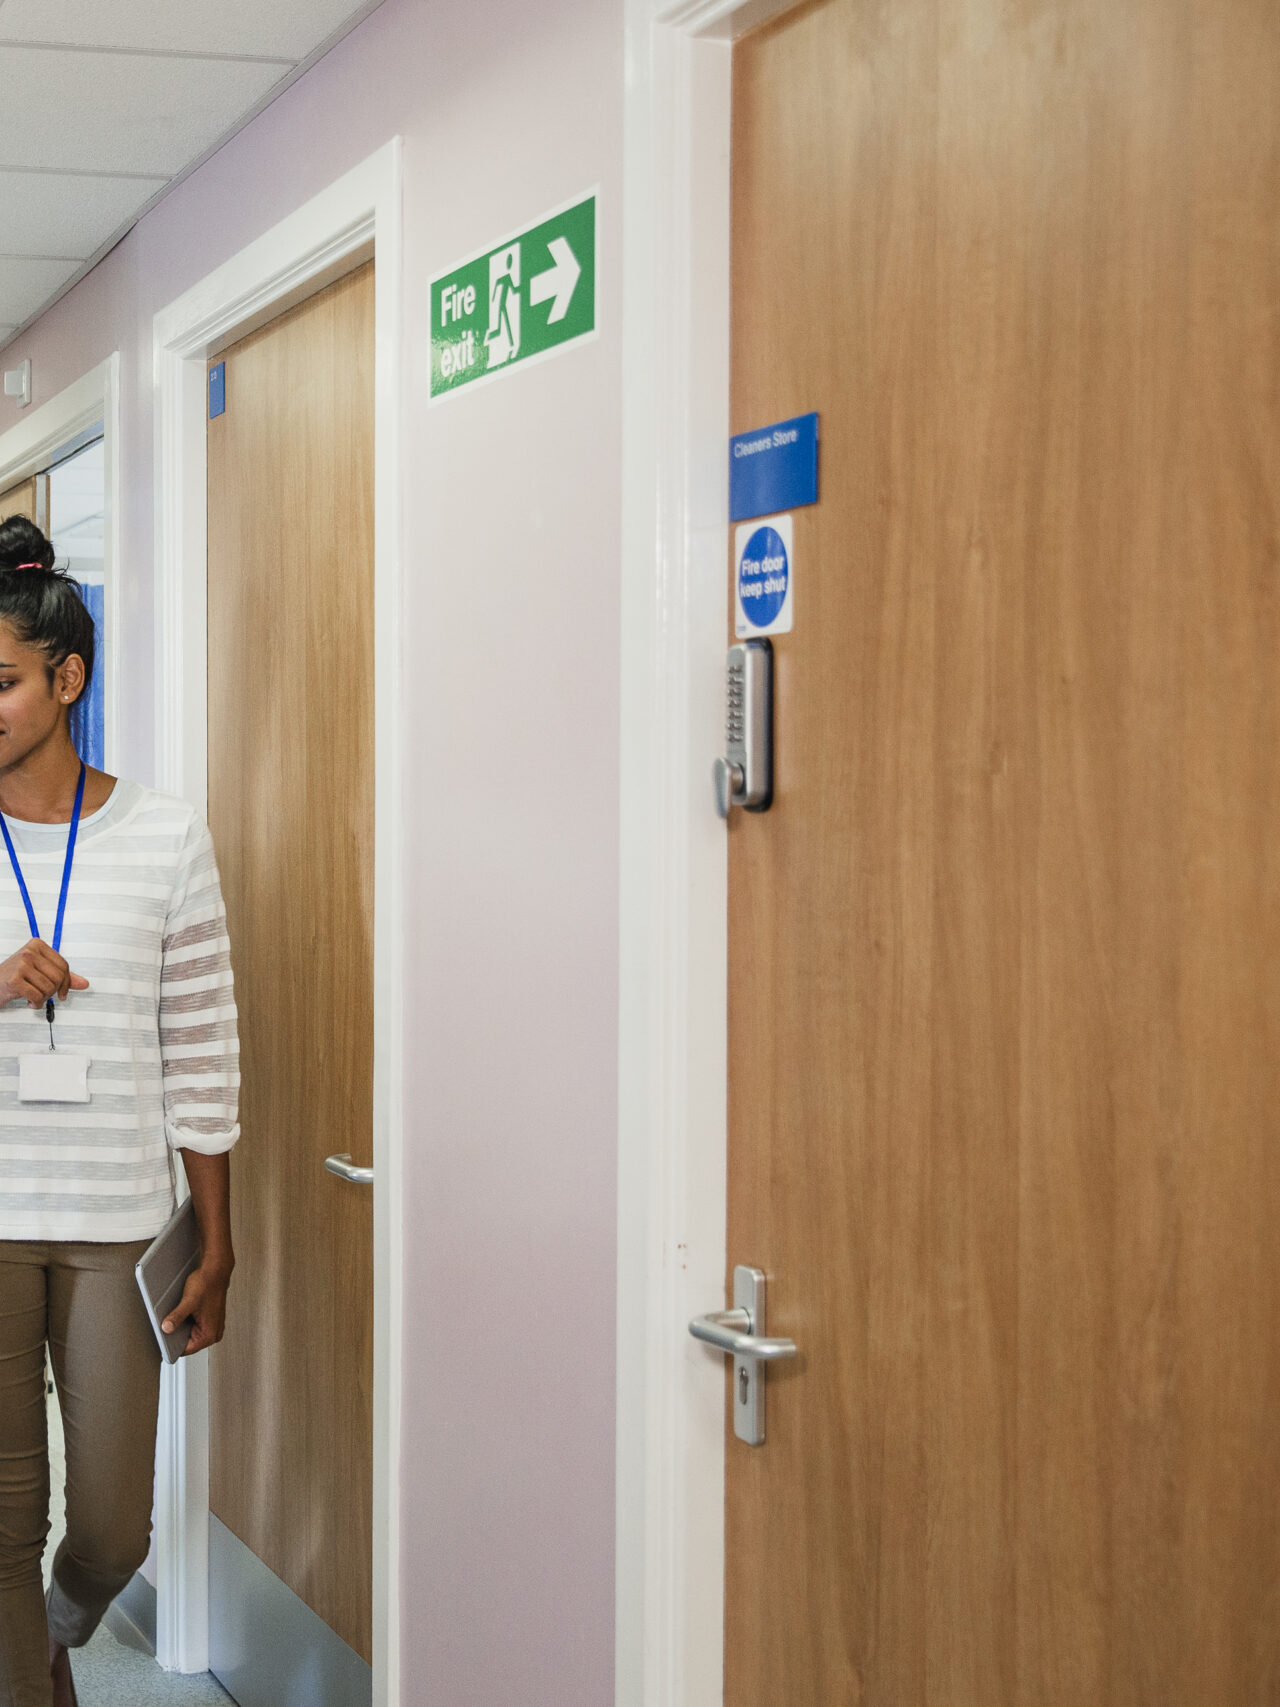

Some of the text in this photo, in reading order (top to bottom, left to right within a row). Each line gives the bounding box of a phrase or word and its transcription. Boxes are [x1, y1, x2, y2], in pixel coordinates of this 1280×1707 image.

[441, 284, 476, 327] Fire
[441, 330, 475, 377] exit
[734, 430, 797, 458] Cleaners Store
[742, 556, 784, 576] Fire door
[740, 576, 786, 600] keep shut
